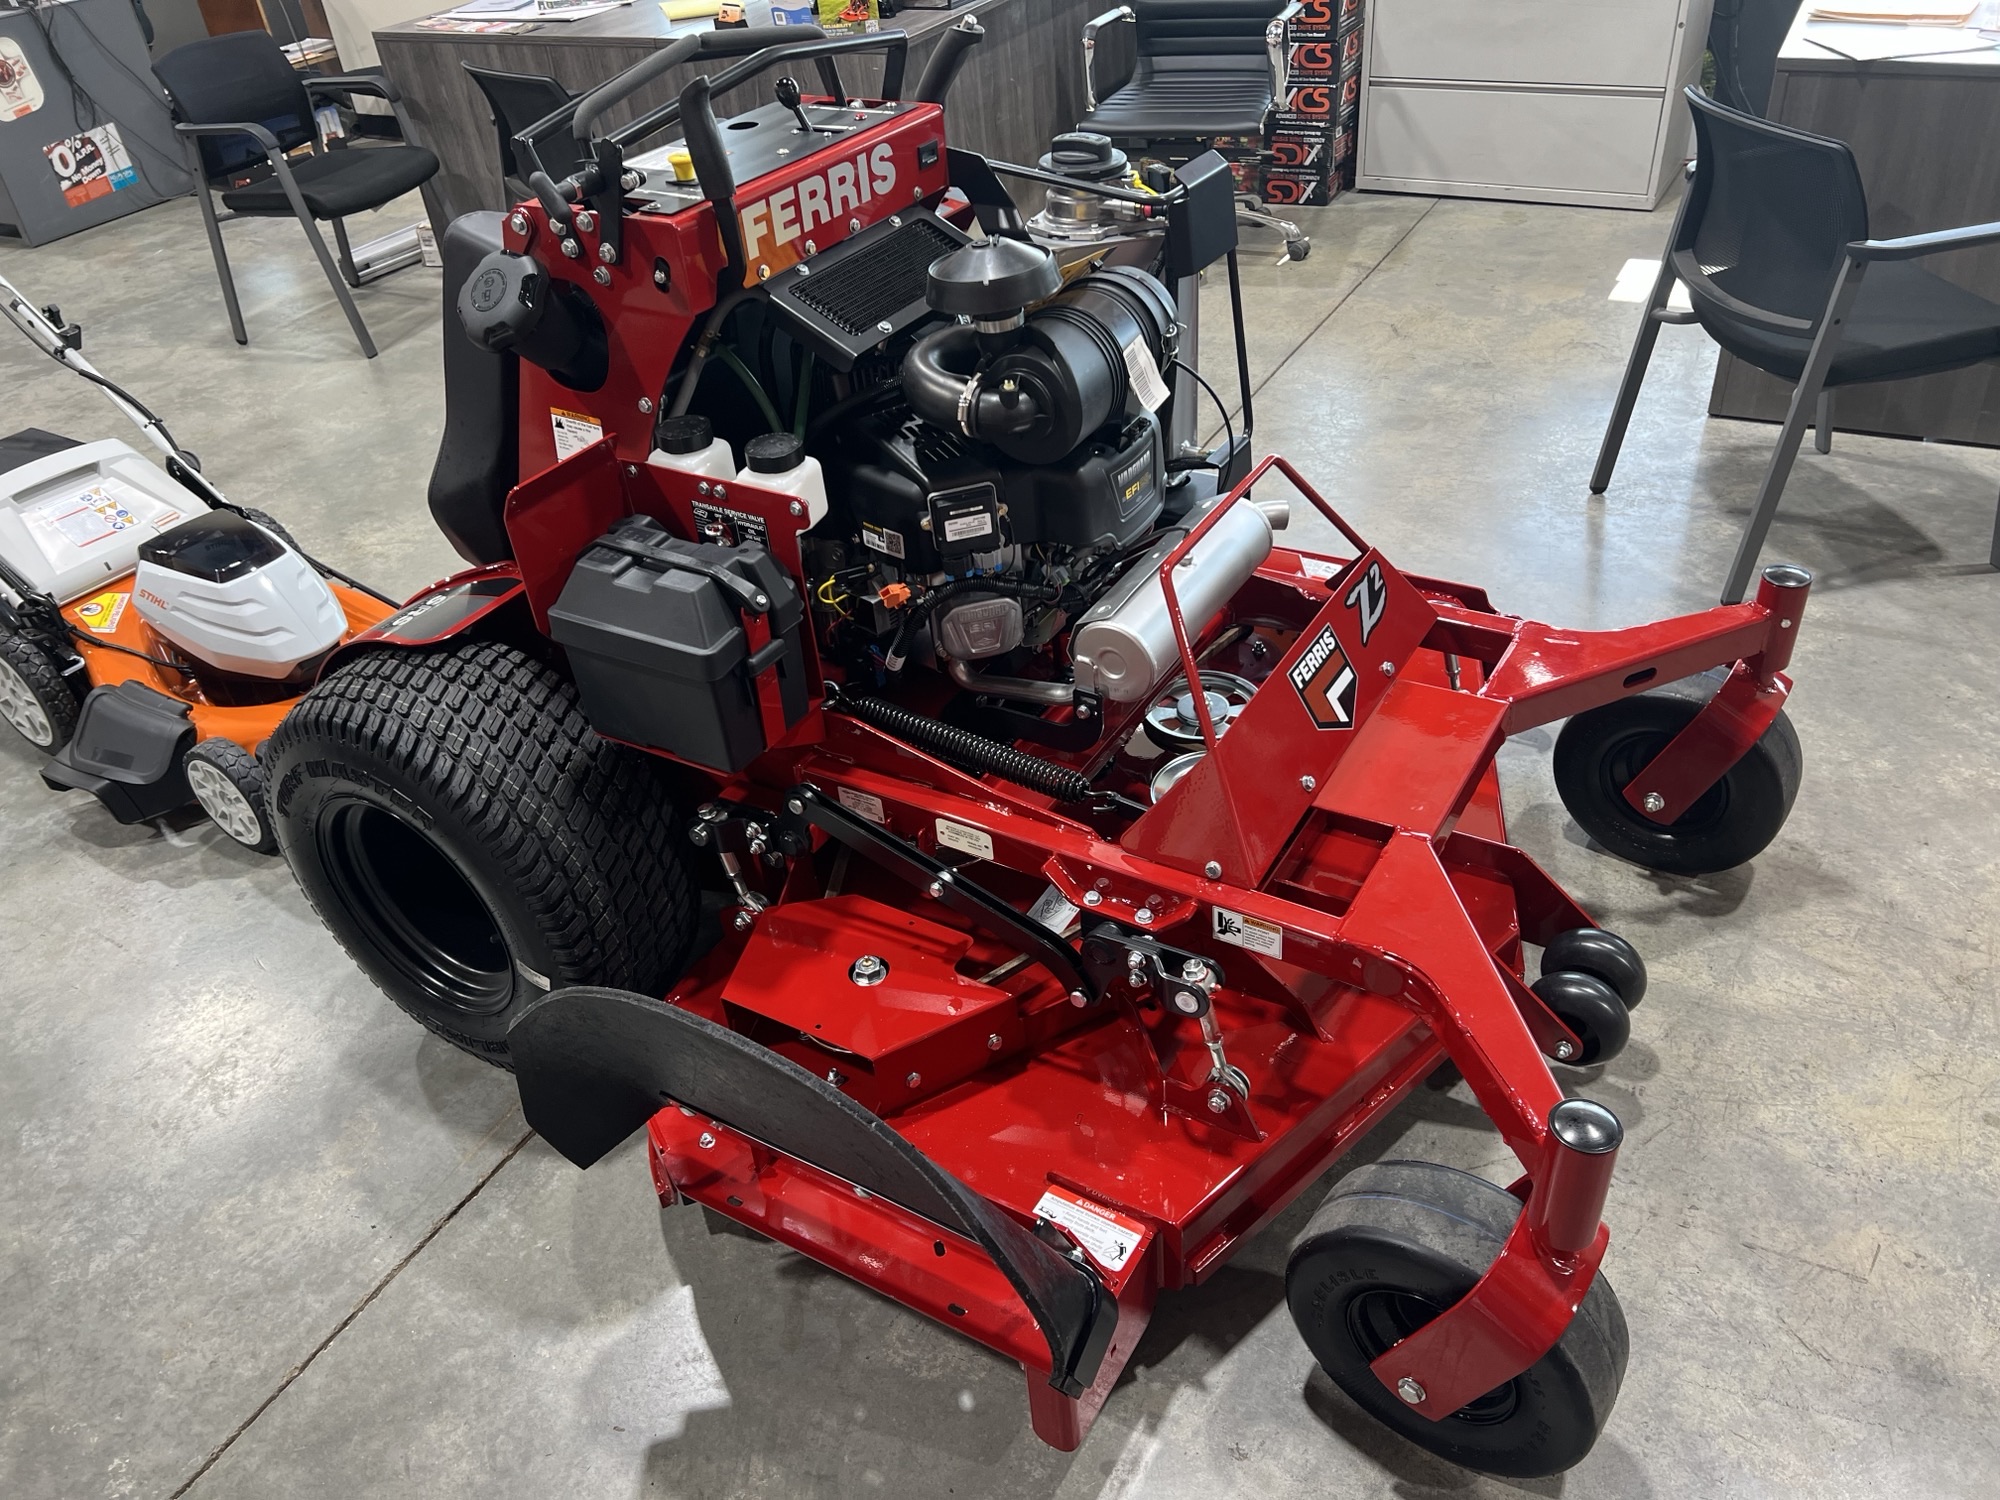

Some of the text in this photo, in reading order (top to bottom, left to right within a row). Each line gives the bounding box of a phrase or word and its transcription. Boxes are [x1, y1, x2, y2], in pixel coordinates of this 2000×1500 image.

[71, 172, 82, 183] No
[81, 157, 104, 176] Money
[82, 167, 102, 184] Down
[740, 142, 897, 261] FERRIS
[1125, 481, 1140, 500] EFI
[691, 500, 765, 524] TRANSAXLE SERVICE VALVE
[139, 589, 167, 611] STIHL
[1291, 630, 1336, 690] FERRIS
[1083, 1201, 1117, 1221] DANGER
